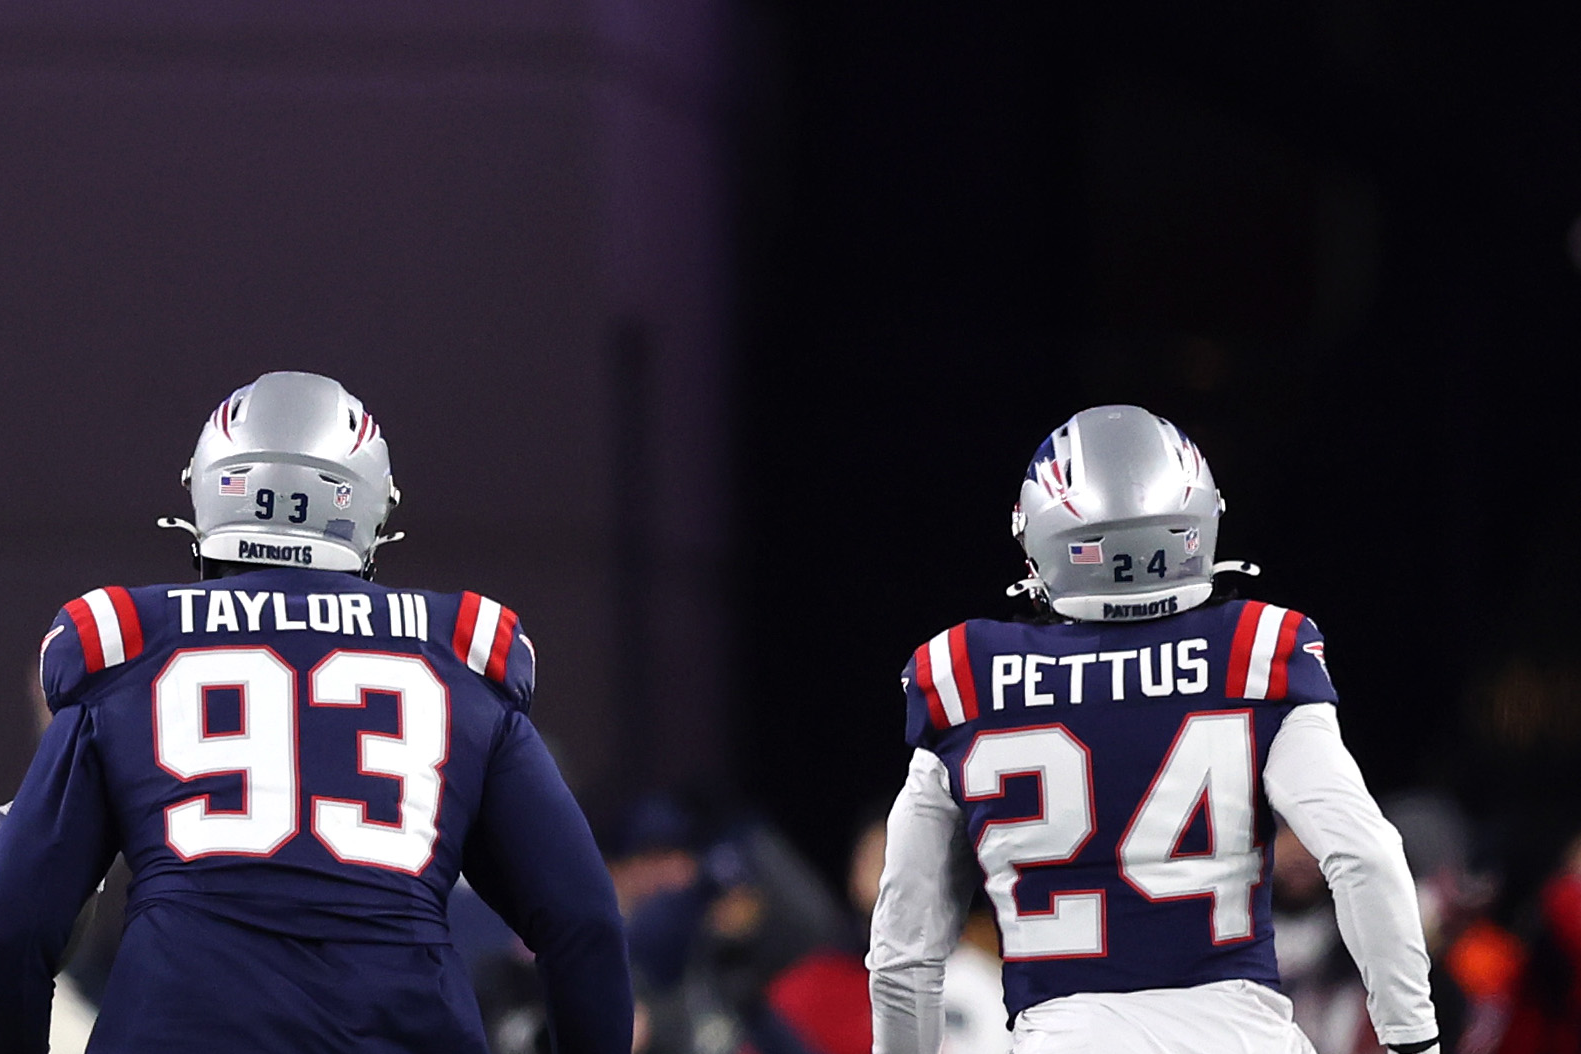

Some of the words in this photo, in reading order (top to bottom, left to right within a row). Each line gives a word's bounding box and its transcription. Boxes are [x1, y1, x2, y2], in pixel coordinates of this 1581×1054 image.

[239, 540, 312, 565] PATRIOTS
[168, 589, 374, 636] TAYLOR
[388, 593, 428, 641] III
[1103, 596, 1177, 618] PATRIOTS
[991, 638, 1208, 711] PETTUS
[151, 644, 450, 877] 93
[961, 708, 1264, 963] 24
